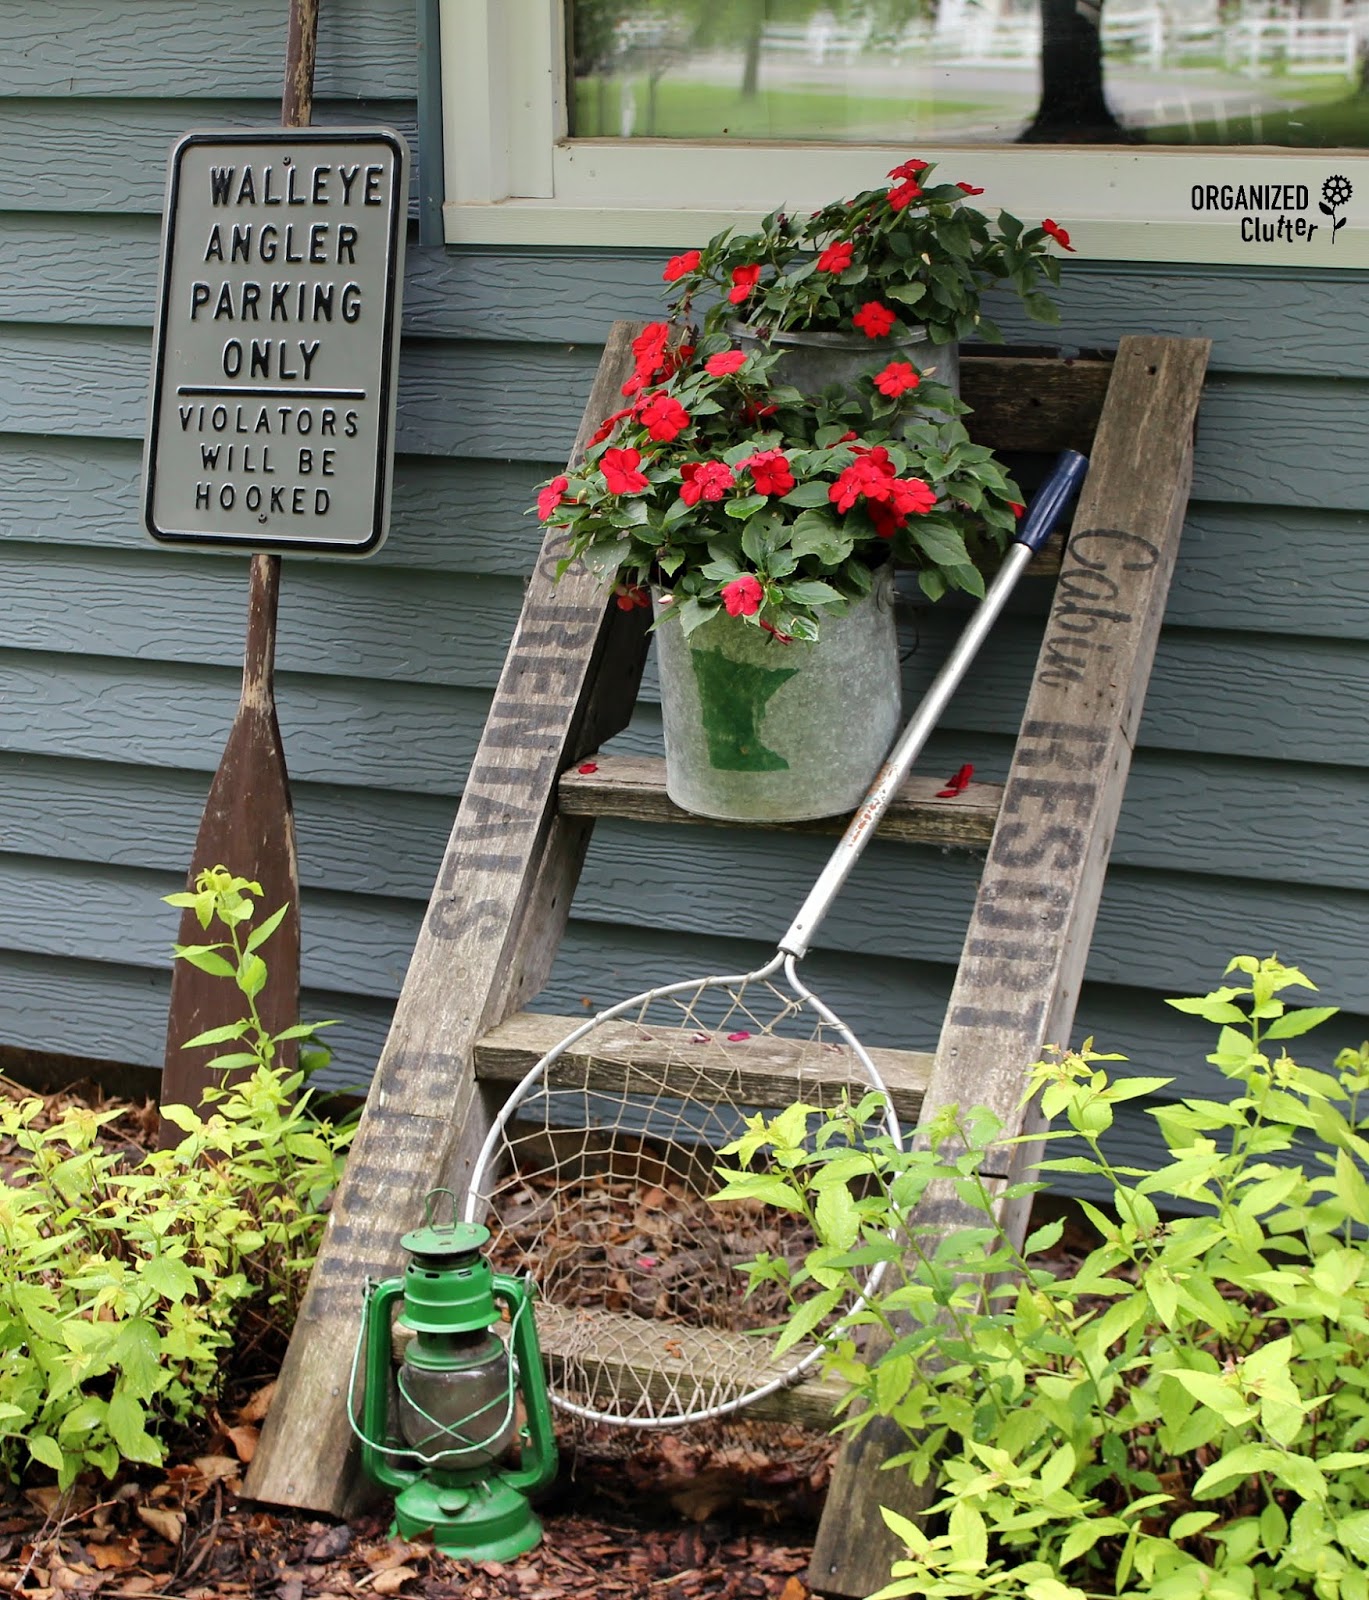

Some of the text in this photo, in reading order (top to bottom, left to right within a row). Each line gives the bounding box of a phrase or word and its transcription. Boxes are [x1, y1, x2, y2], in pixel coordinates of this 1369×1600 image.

[208, 165, 384, 207] WALLEYE
[203, 222, 359, 265] ANGLER
[189, 281, 362, 324] PARKING
[222, 337, 321, 380] ONLY
[177, 404, 360, 438] VIOLATORS
[200, 443, 337, 476] WILL BE
[195, 482, 330, 515] HOOKED
[428, 605, 601, 941] RENTALS
[949, 528, 1160, 1048] Cabin RESORT
